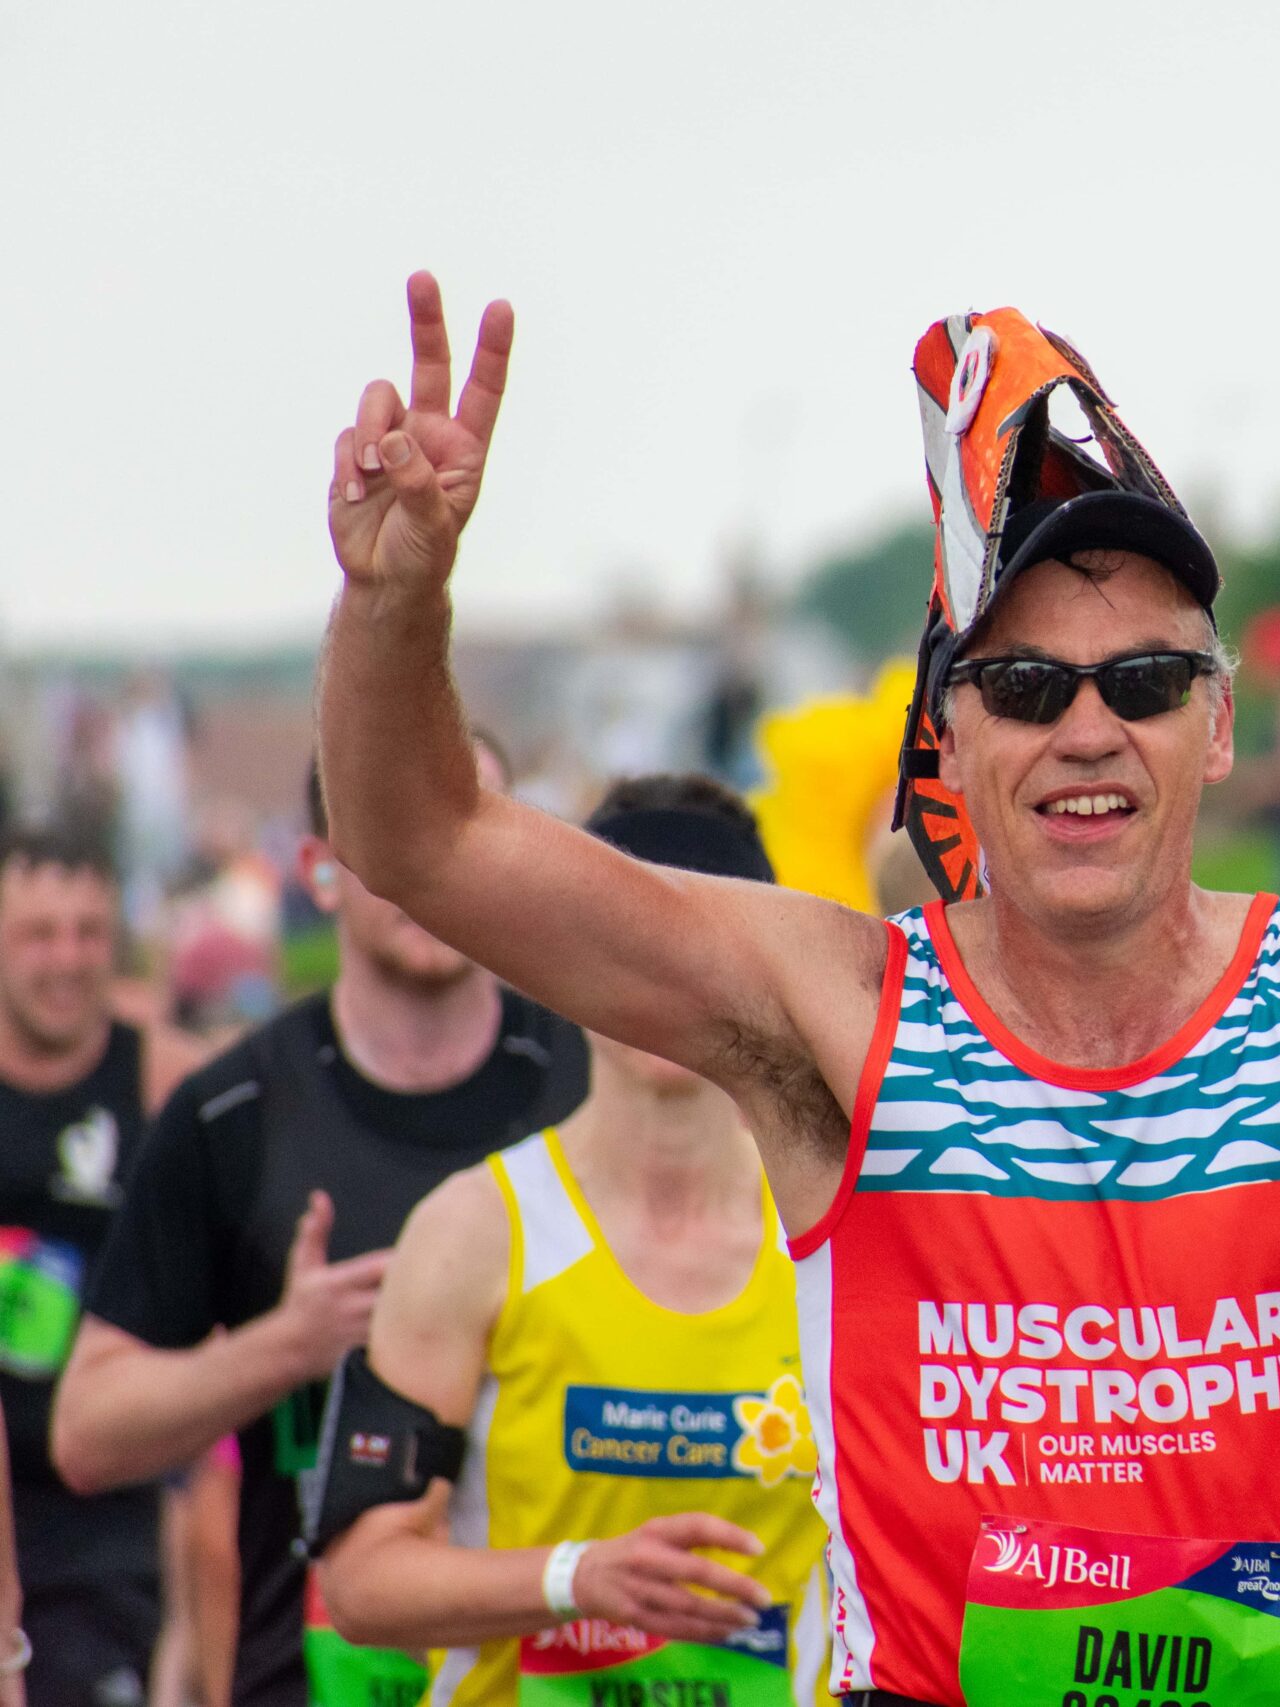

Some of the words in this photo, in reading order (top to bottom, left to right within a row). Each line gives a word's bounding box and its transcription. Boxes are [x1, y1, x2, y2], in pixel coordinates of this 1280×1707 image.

[602, 1401, 667, 1430] Marie
[670, 1405, 727, 1432] Curie
[571, 1427, 661, 1464] Cancer
[667, 1435, 727, 1466] Care
[923, 1428, 1016, 1486] UK
[1038, 1434, 1095, 1456] OUR
[1101, 1431, 1216, 1456] MUSCLES
[1039, 1462, 1143, 1483] MATTER
[1237, 1580, 1262, 1593] great
[1073, 1624, 1213, 1694] DAVID
